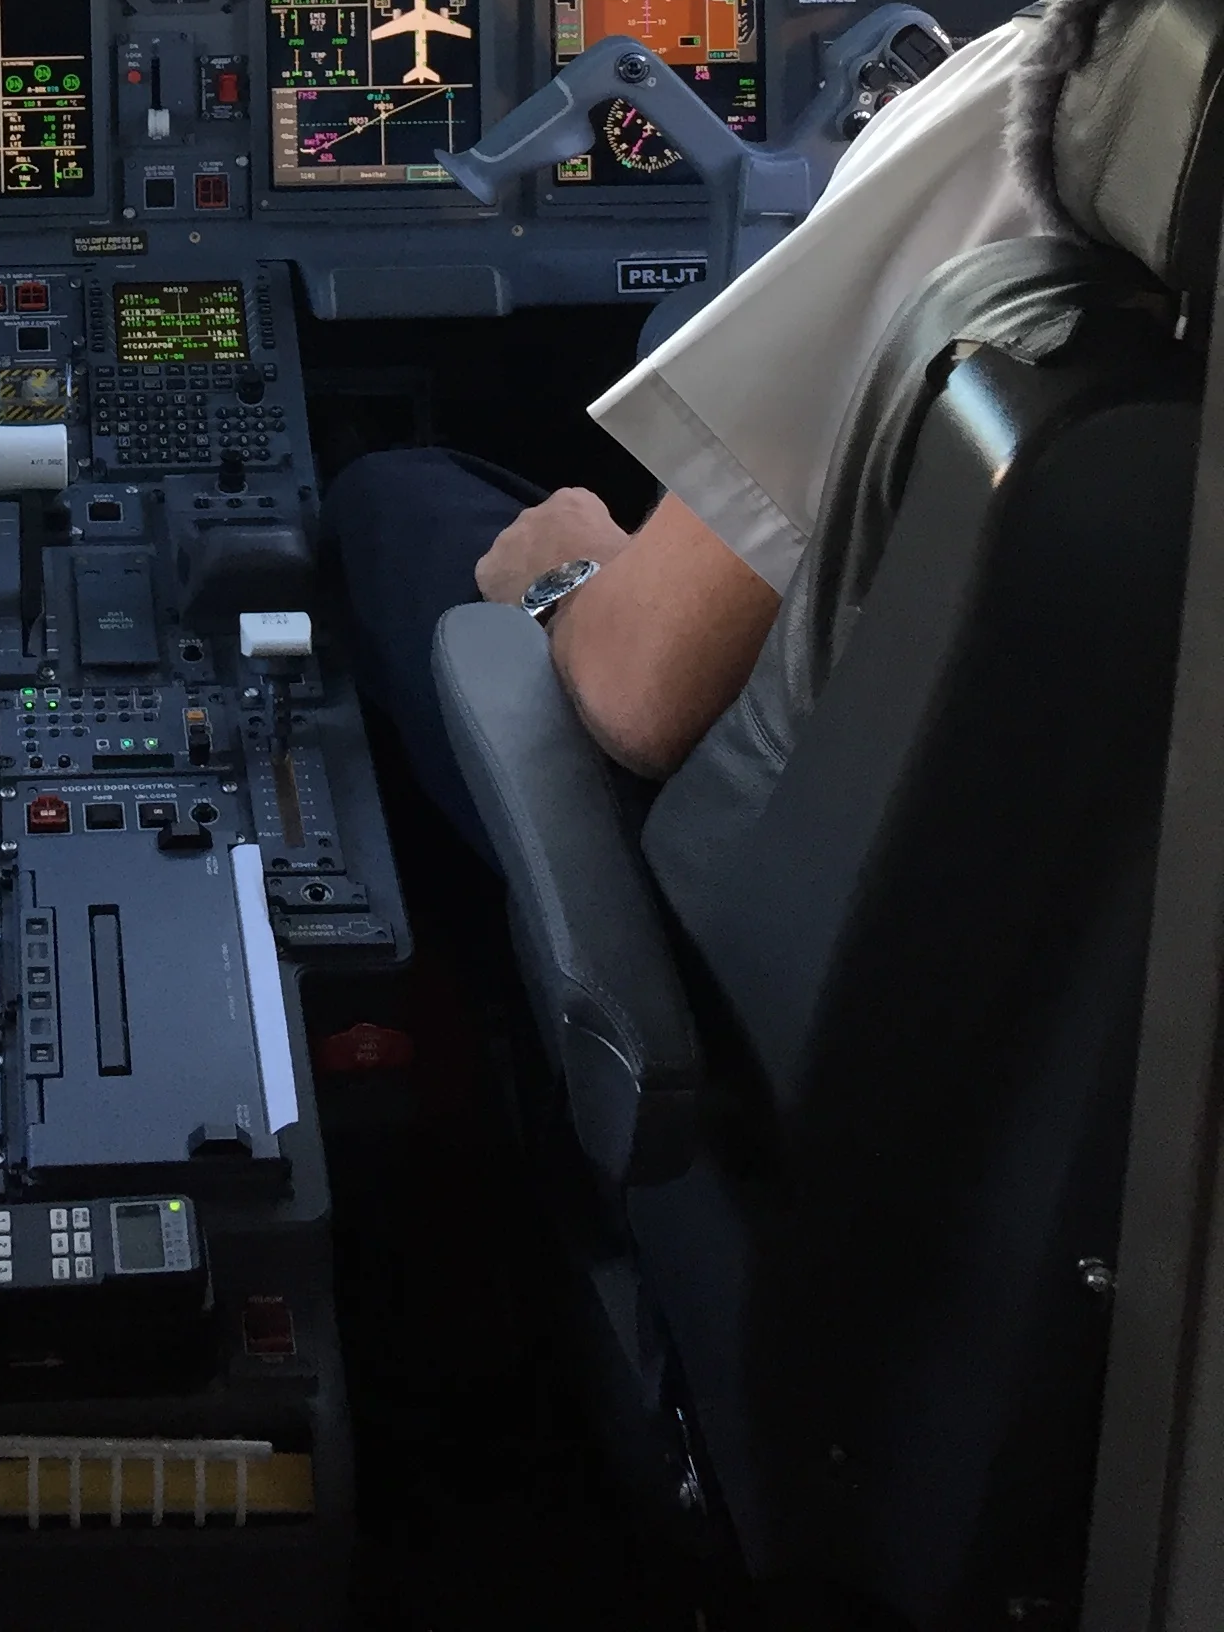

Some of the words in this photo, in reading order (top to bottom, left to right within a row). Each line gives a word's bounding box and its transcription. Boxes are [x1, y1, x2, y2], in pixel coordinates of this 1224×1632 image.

[627, 266, 699, 286] PR-LJT
[60, 784, 102, 793] COCKPIT
[102, 783, 131, 792] DOOR
